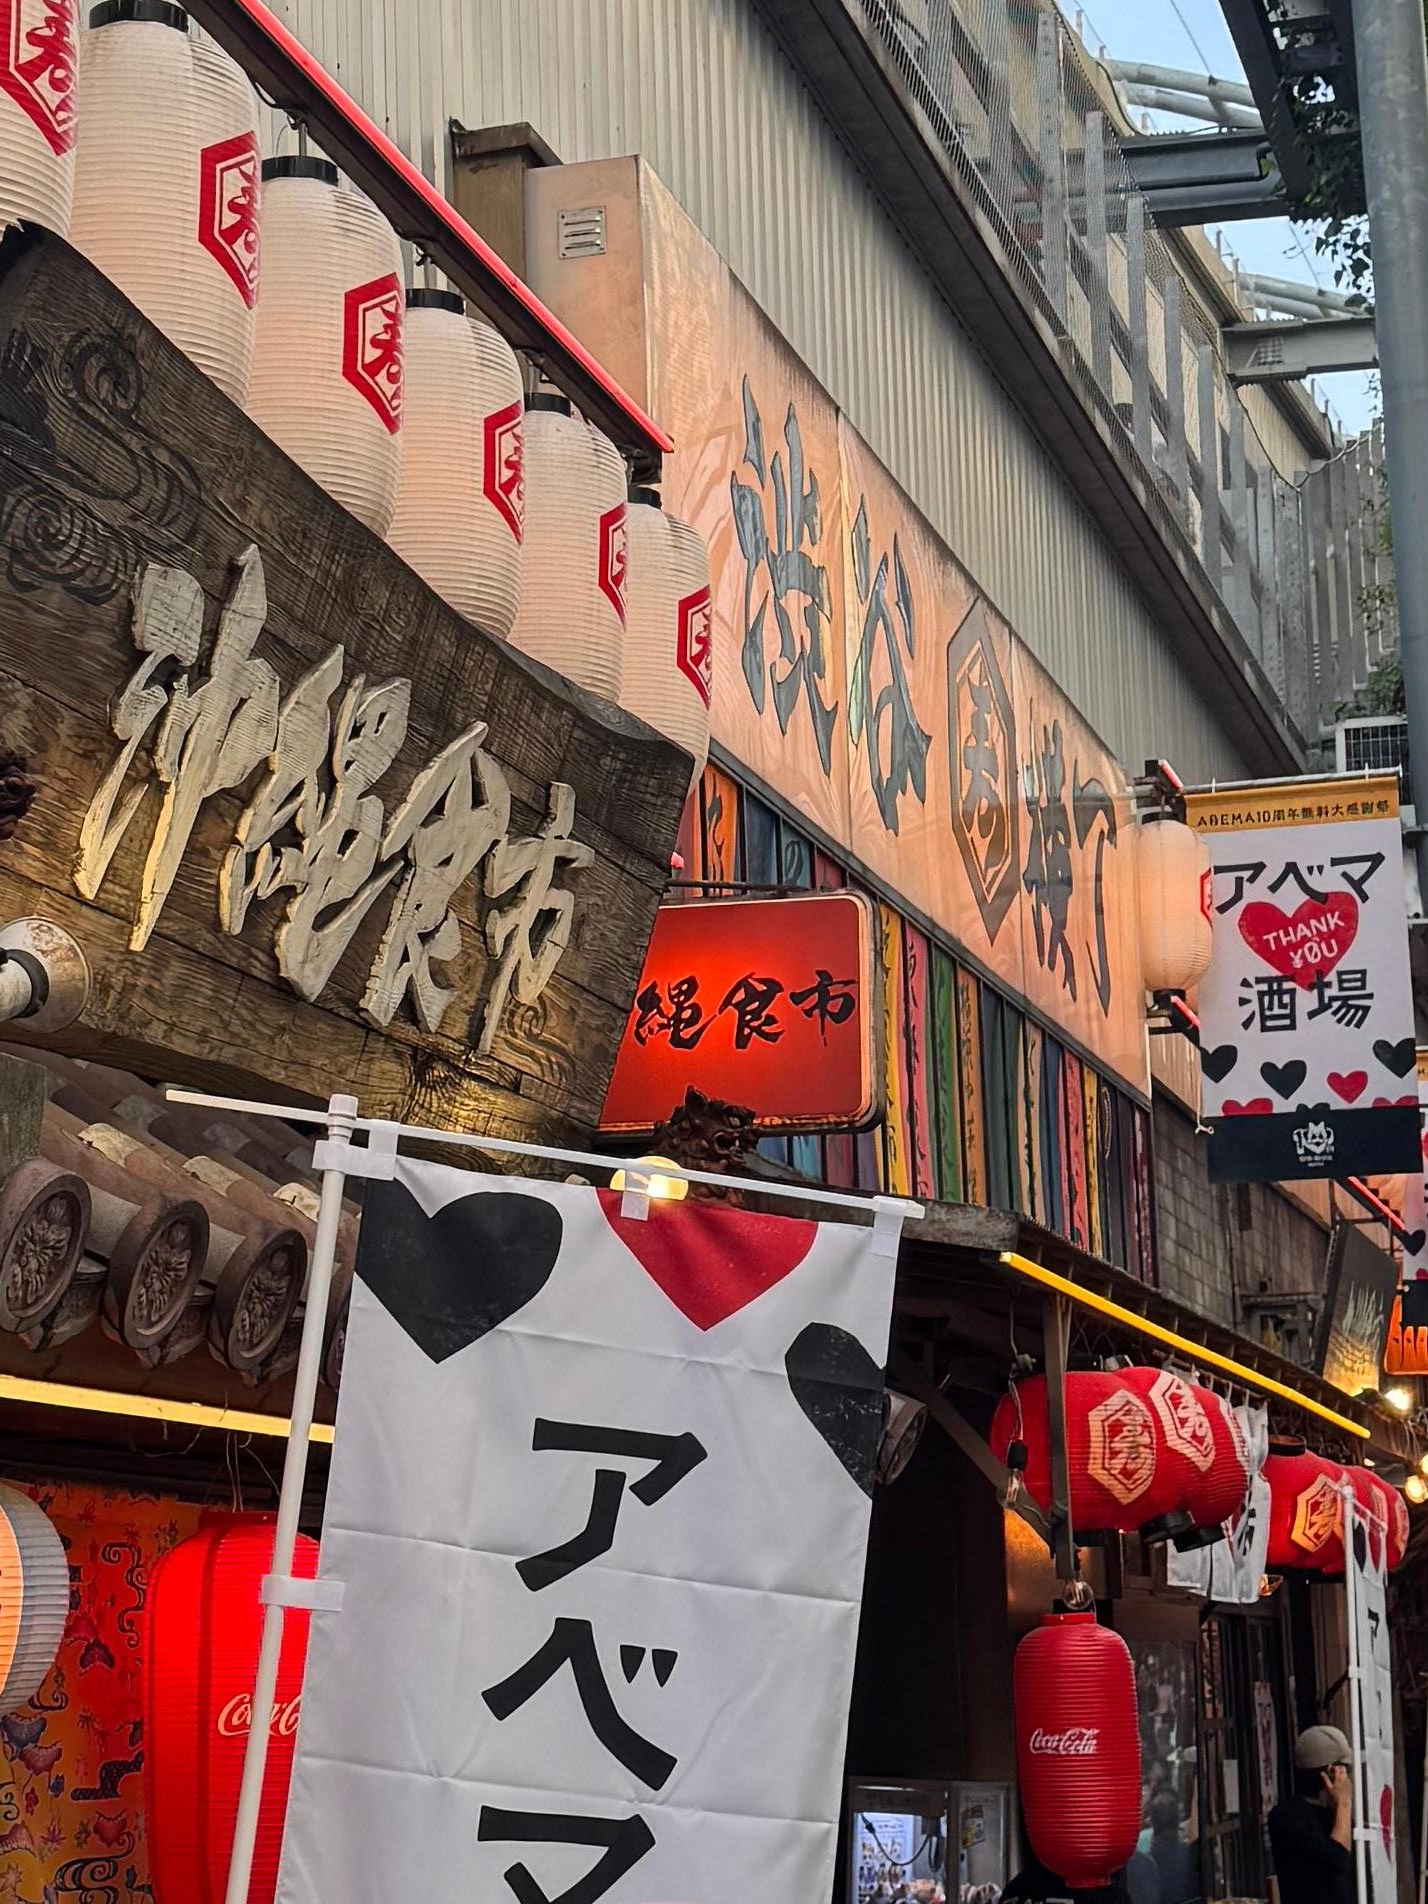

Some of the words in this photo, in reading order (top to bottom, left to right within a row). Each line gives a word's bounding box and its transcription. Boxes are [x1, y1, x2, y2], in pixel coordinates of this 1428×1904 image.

[730, 374, 932, 836] 渋谷
[1022, 698, 1118, 1017] 横丁
[75, 542, 594, 1053] 沖縄食市
[1214, 851, 1387, 915] アベマ
[1262, 911, 1346, 954] THANK
[1236, 967, 1375, 1035] 酒場
[1028, 1727, 1101, 1755] Coca-Cola
